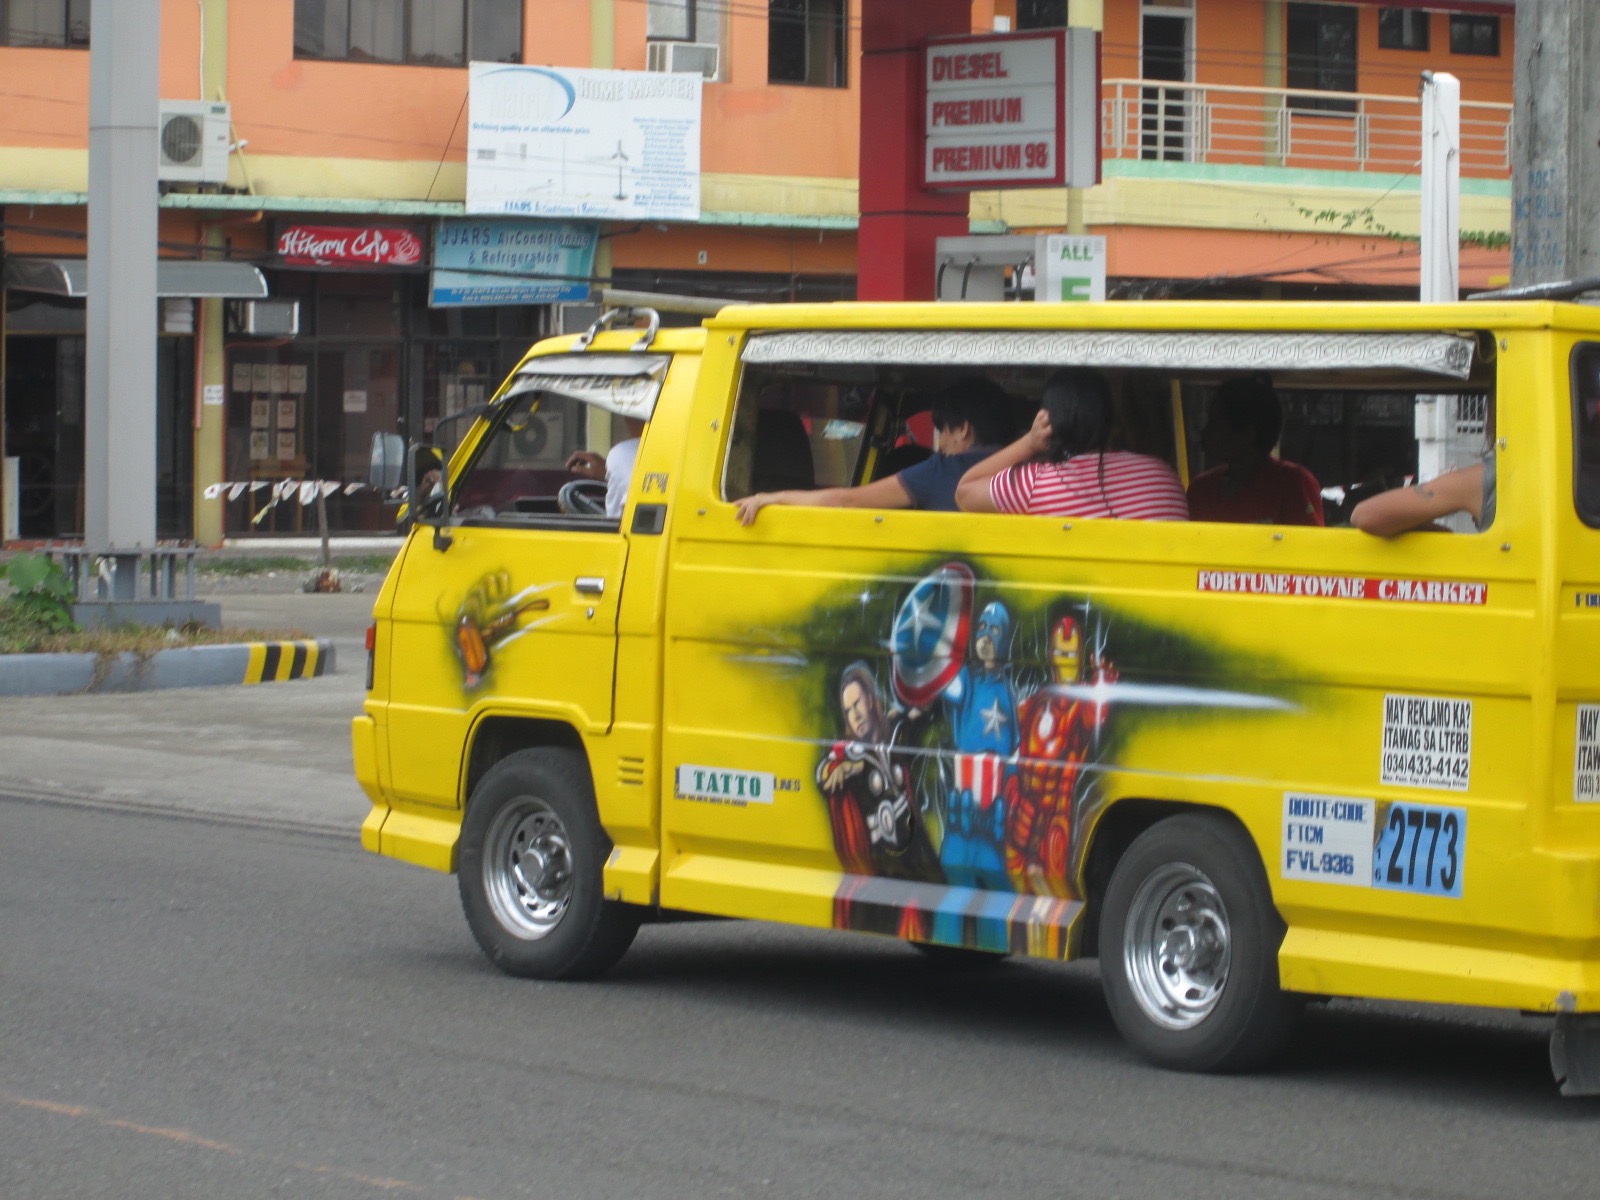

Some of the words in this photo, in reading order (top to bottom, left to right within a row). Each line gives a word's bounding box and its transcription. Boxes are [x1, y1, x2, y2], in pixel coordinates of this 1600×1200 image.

[932, 52, 1007, 82] DIESEL
[578, 76, 624, 101] HOME
[628, 75, 695, 101] MASTER
[932, 97, 1022, 126] PREMIUM
[932, 144, 1021, 172] PREMIUM
[1025, 143, 1049, 170] 98
[278, 227, 348, 258] Hikaru
[441, 227, 491, 246] JJARS
[481, 250, 560, 267] Refrigeration
[1060, 245, 1093, 261] ALL
[1378, 578, 1486, 605] C.MARKET
[1386, 697, 1405, 725] MAY
[1407, 699, 1451, 728] REKLAMO
[1453, 702, 1471, 730] KA?
[1579, 709, 1600, 742] MAY
[1383, 727, 1421, 750] ITAWAG
[1424, 730, 1436, 752] SA
[1439, 731, 1469, 754] LTFRB
[1383, 752, 1469, 778] (034)433-4142
[693, 769, 762, 798] TATTO
[1287, 823, 1324, 845] FTCM
[1386, 807, 1459, 890] 2773
